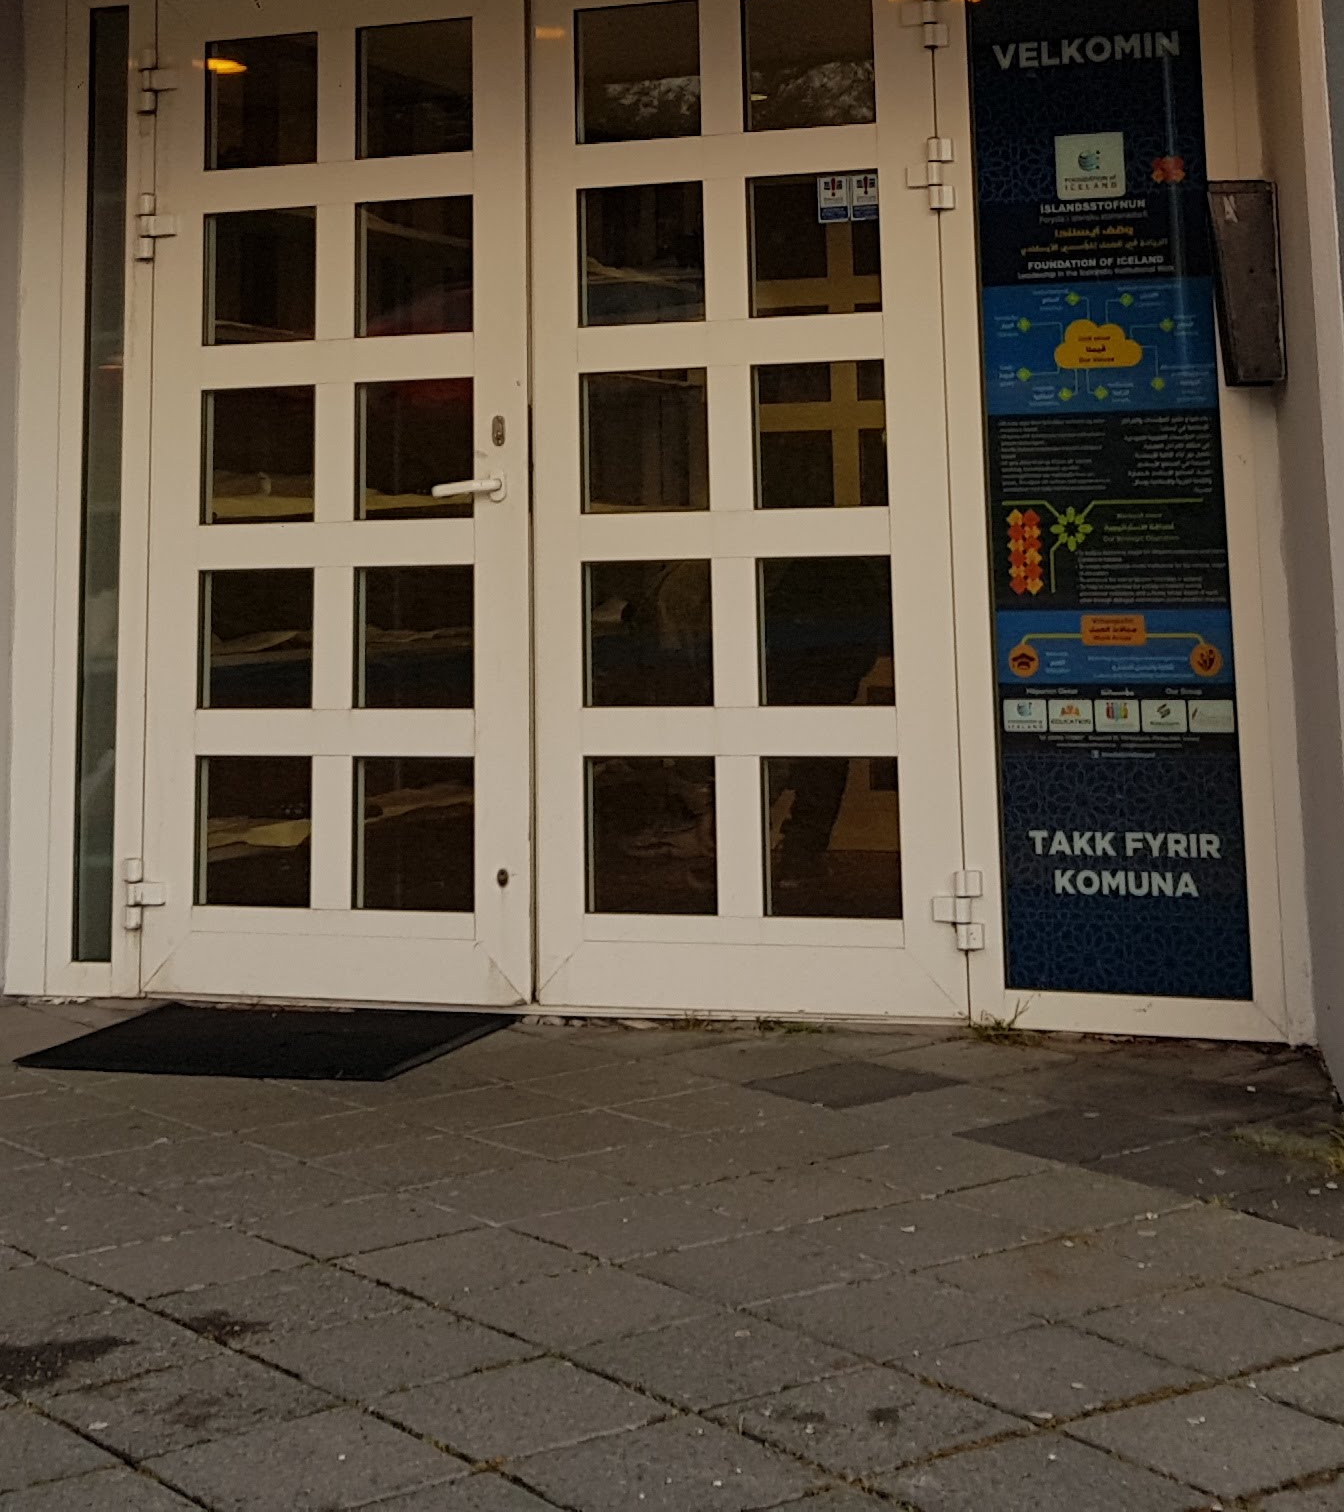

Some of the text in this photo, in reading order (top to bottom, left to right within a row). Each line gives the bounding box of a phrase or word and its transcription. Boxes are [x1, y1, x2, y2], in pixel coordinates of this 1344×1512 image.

[992, 30, 1180, 70] VELKOMIN
[1027, 255, 1165, 271] FOUNDATION OF ICELAND
[1028, 830, 1222, 859] TAKK FYRIR
[1055, 869, 1199, 898] KOMUNA
